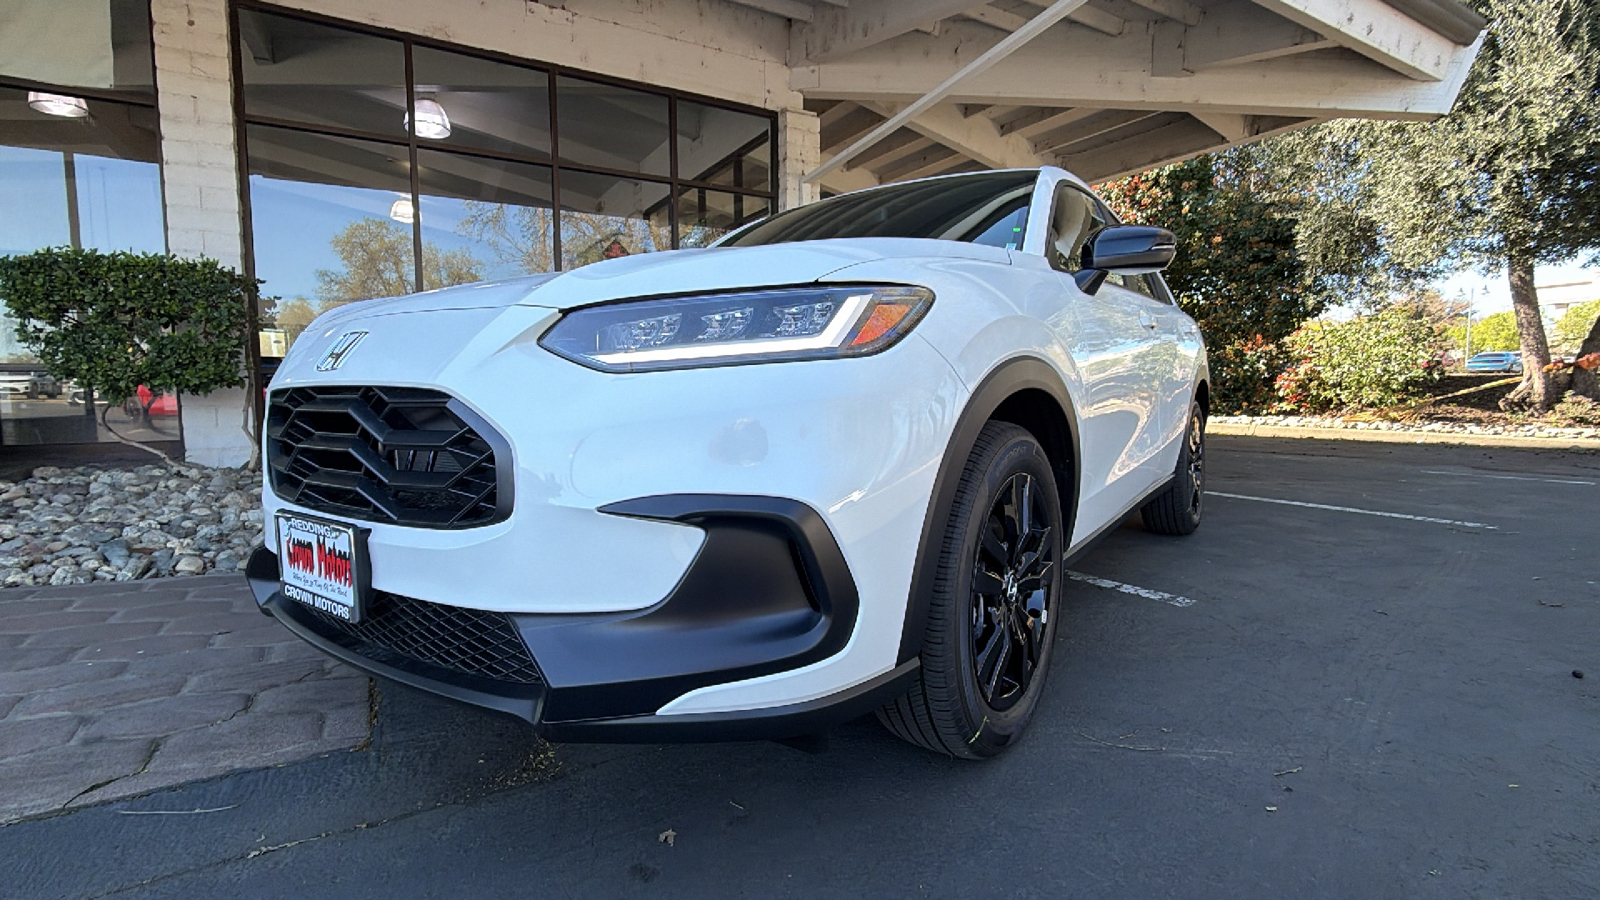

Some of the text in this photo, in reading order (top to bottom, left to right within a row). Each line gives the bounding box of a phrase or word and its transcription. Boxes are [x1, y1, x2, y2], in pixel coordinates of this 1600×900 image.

[291, 518, 331, 537] REDDING
[317, 535, 352, 588] Motors
[284, 585, 349, 619] CROWN MOTORS
